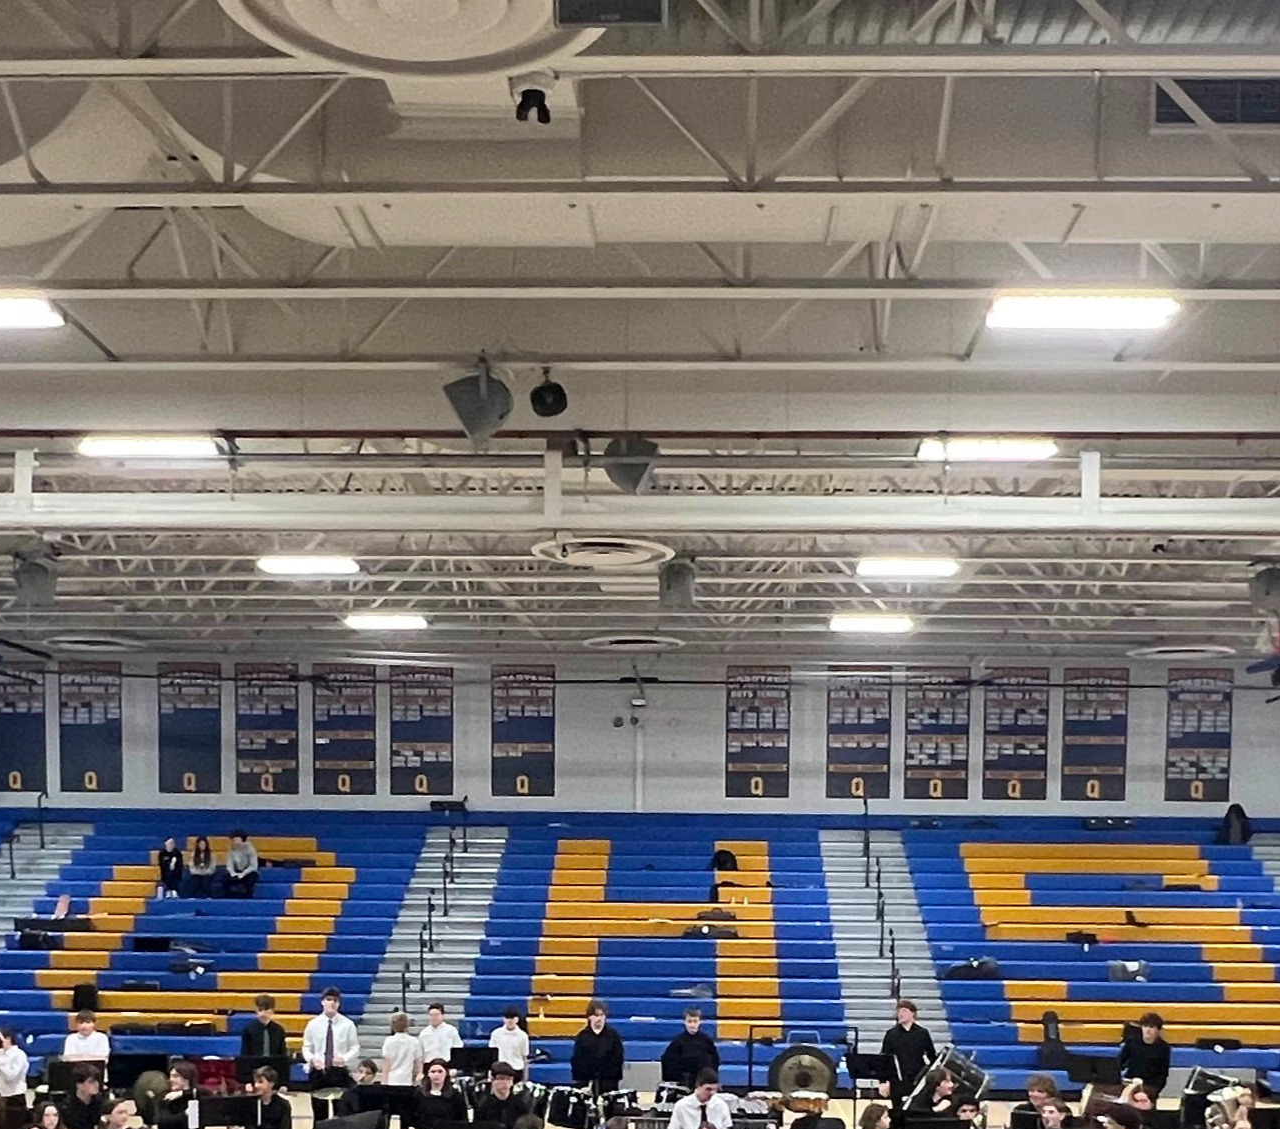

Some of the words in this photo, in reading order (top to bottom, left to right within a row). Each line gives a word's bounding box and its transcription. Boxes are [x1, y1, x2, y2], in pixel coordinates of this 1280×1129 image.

[8, 770, 22, 789] Q
[84, 771, 98, 790] Q
[183, 772, 196, 792] Q
[260, 773, 274, 792] Q
[338, 774, 351, 793] Q
[414, 774, 428, 793] Q
[516, 775, 529, 794] Q
[750, 776, 764, 796] Q
[851, 777, 864, 796] Q
[929, 779, 943, 797] Q
[1007, 779, 1021, 798] Q
[1086, 780, 1100, 799] Q
[1190, 780, 1204, 799] Q
